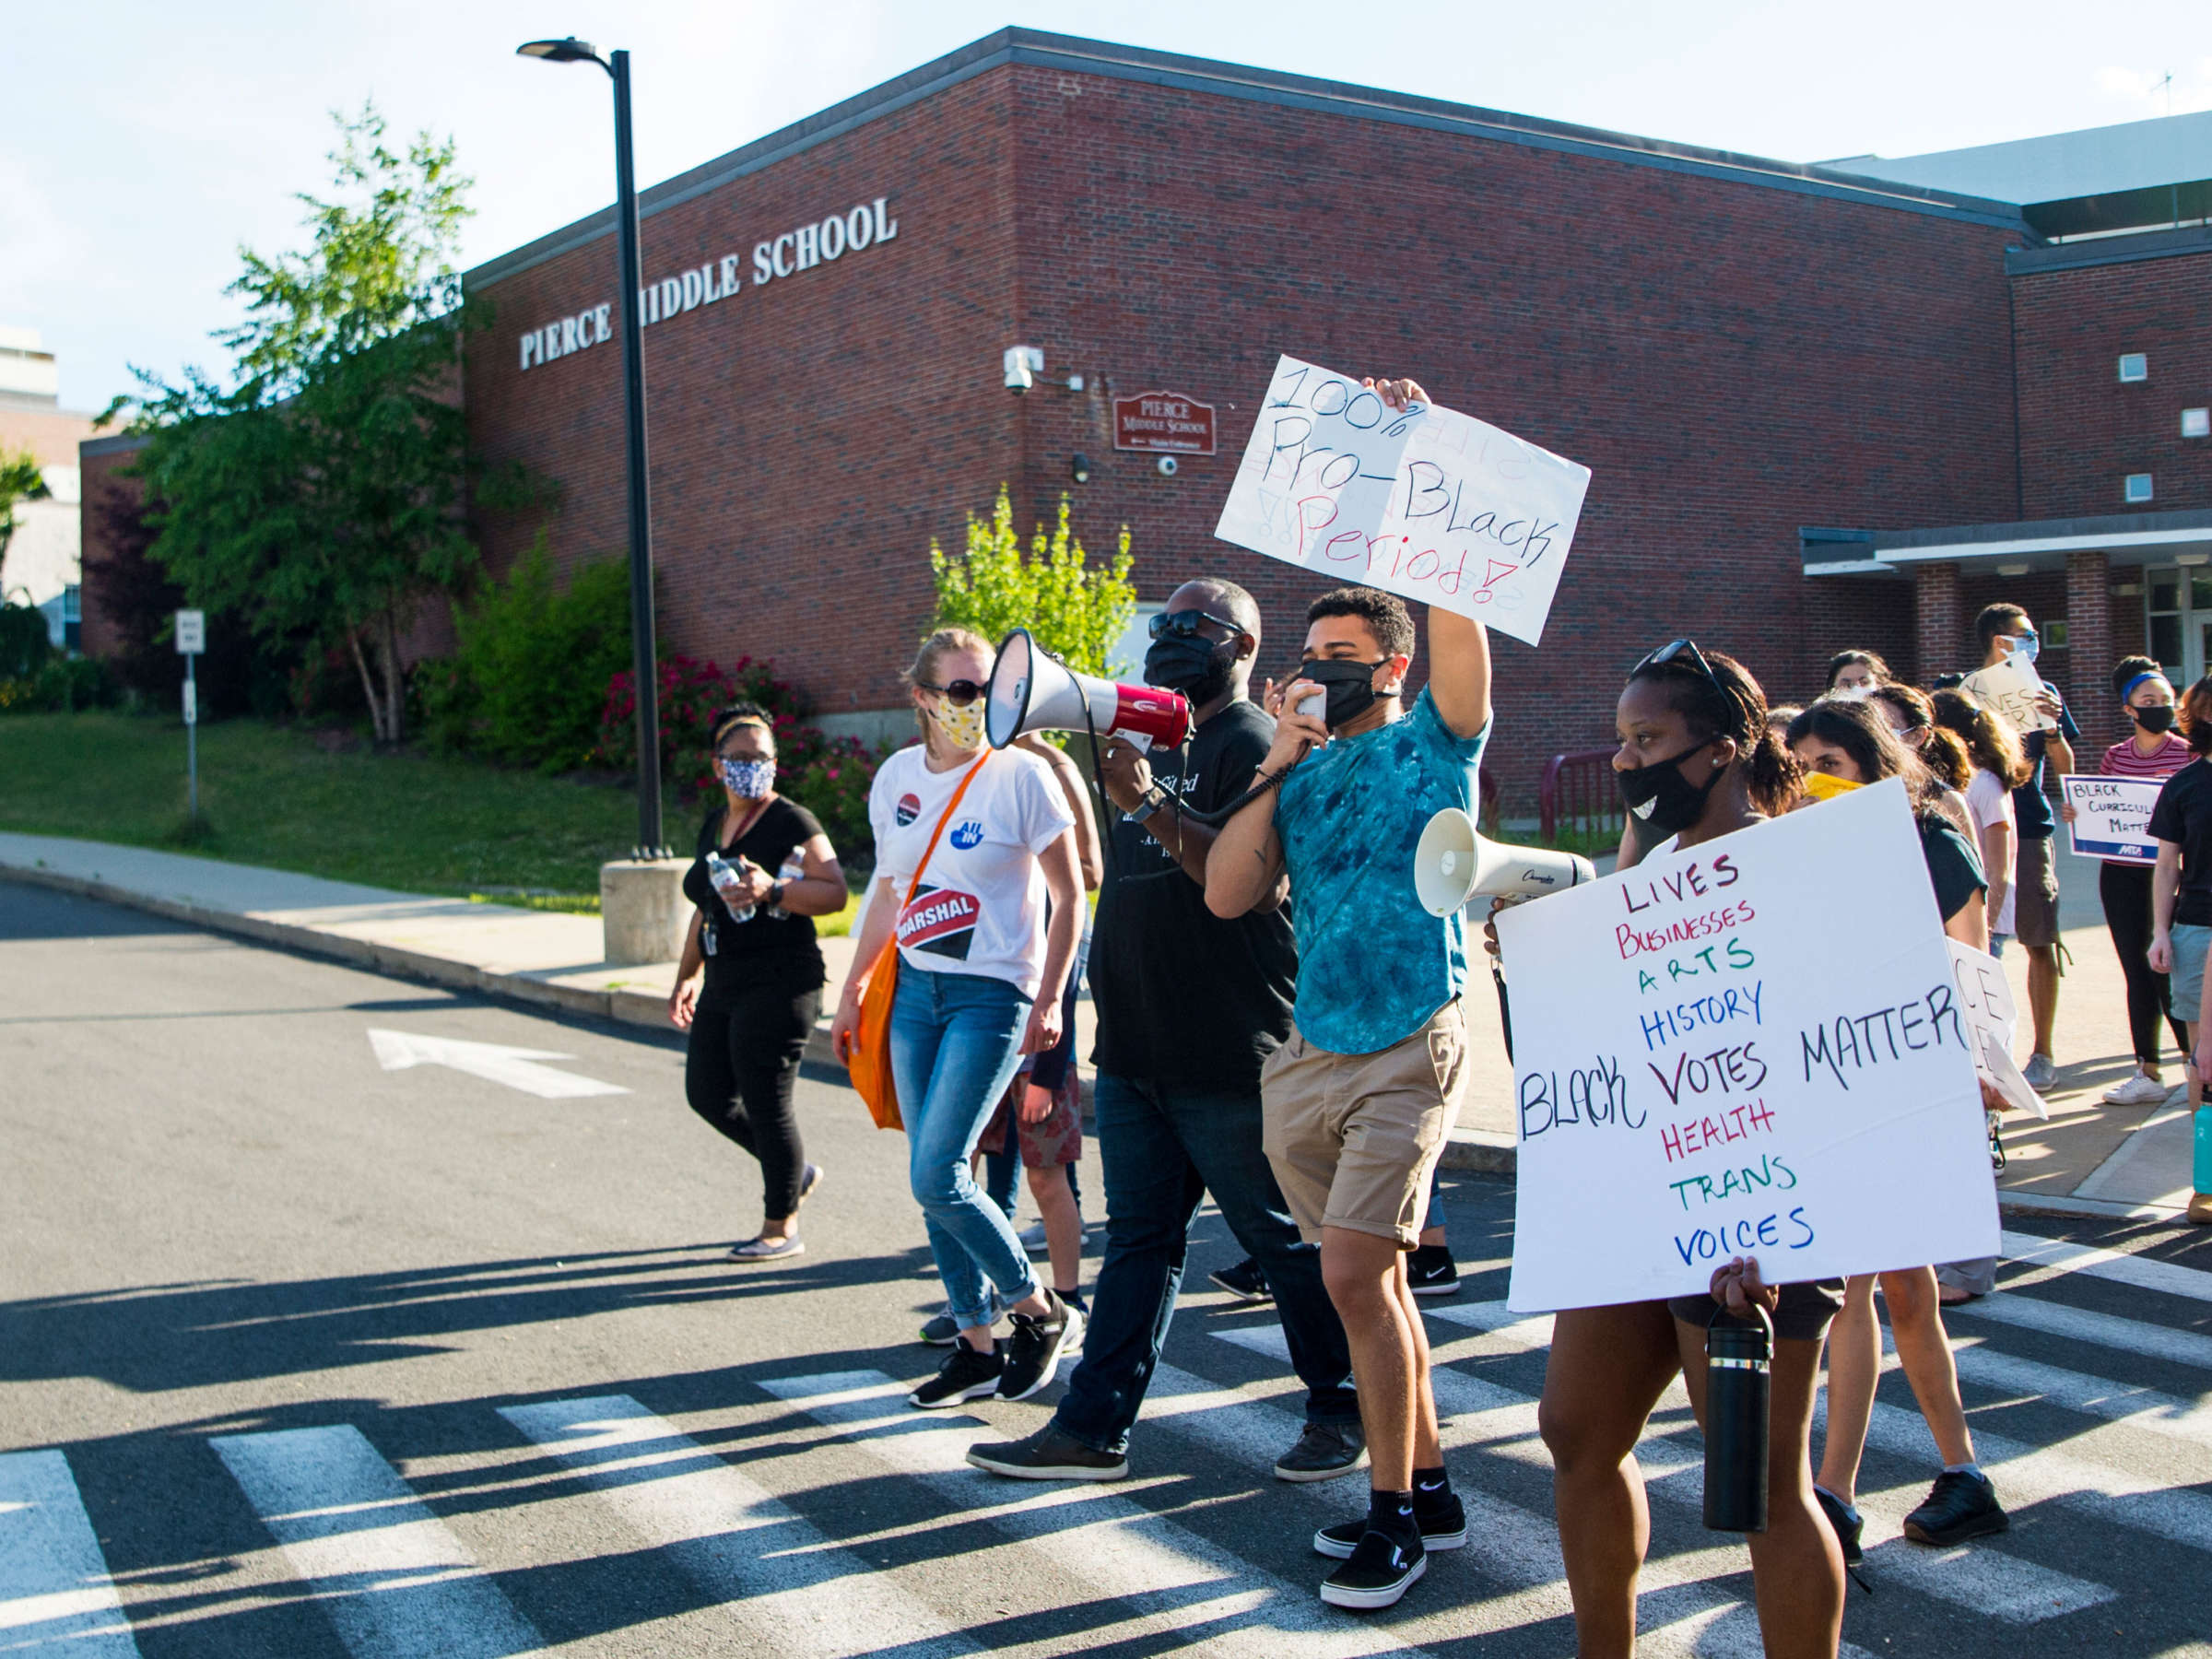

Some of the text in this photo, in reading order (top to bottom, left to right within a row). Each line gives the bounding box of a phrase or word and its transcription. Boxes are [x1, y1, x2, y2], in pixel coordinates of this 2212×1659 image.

[519, 196, 899, 371] PIERCE IDDLE SCHOOL
[1141, 400, 1190, 419] PIERCE
[1267, 368, 1427, 438] 100%
[2073, 783, 2123, 798] BLACK
[2088, 800, 2154, 815] CURRICUL
[961, 832, 979, 844] IN
[2109, 818, 2150, 833] MATTE
[1621, 853, 1739, 914] LIVES
[1616, 900, 1756, 959] BUSINESSES
[1639, 937, 1756, 994] ARTS
[1640, 981, 1763, 1051] HISTORY
[1520, 1054, 1647, 1142] BLACK
[1647, 1041, 1769, 1106] VOTES
[1800, 983, 1970, 1090] MATTER
[1660, 1098, 1776, 1163] HEALTH
[1669, 1155, 1798, 1211] TRANS
[1674, 1207, 1815, 1266] VOICES
